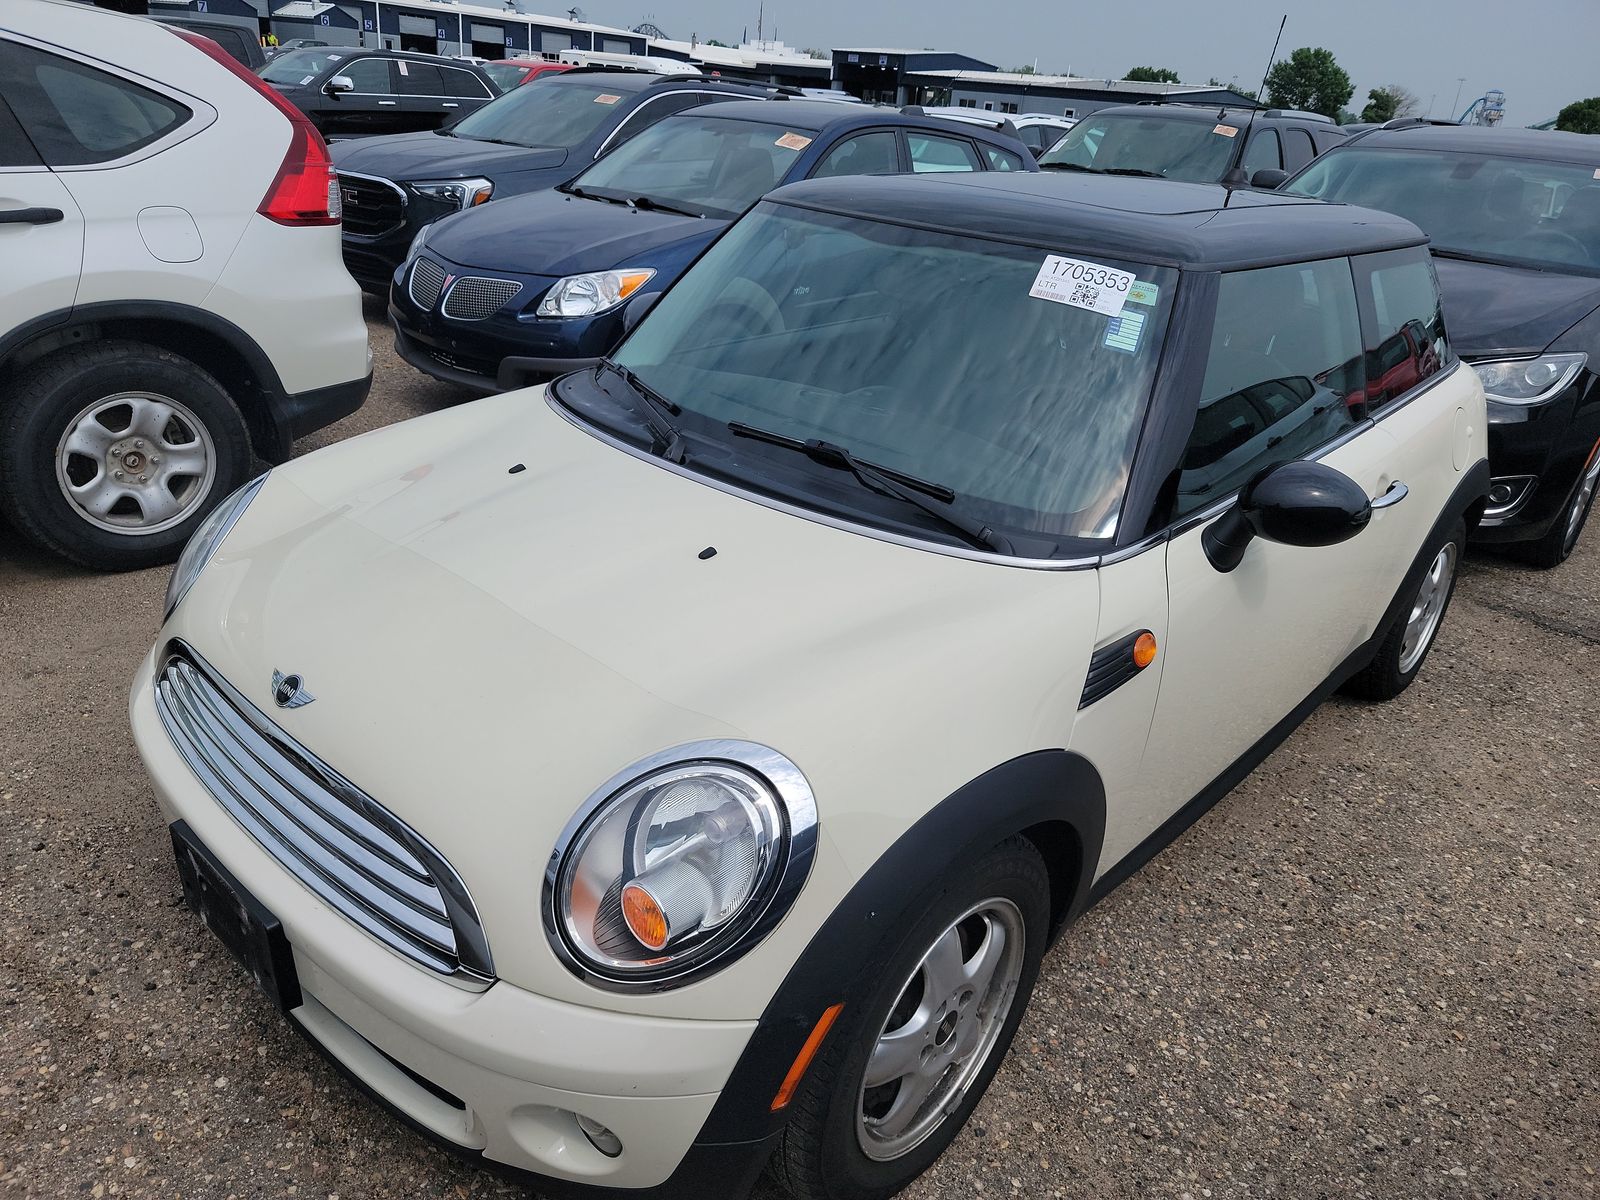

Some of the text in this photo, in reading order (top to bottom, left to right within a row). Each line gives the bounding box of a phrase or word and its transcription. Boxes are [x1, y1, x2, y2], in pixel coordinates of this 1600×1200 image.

[199, 1, 206, 12] 7
[322, 15, 328, 25] 6
[366, 20, 372, 29] 5
[439, 29, 445, 38] 4
[507, 38, 512, 46] 3
[1052, 260, 1130, 292] 1705353
[1038, 279, 1058, 290] LTR
[280, 681, 296, 698] MINI
